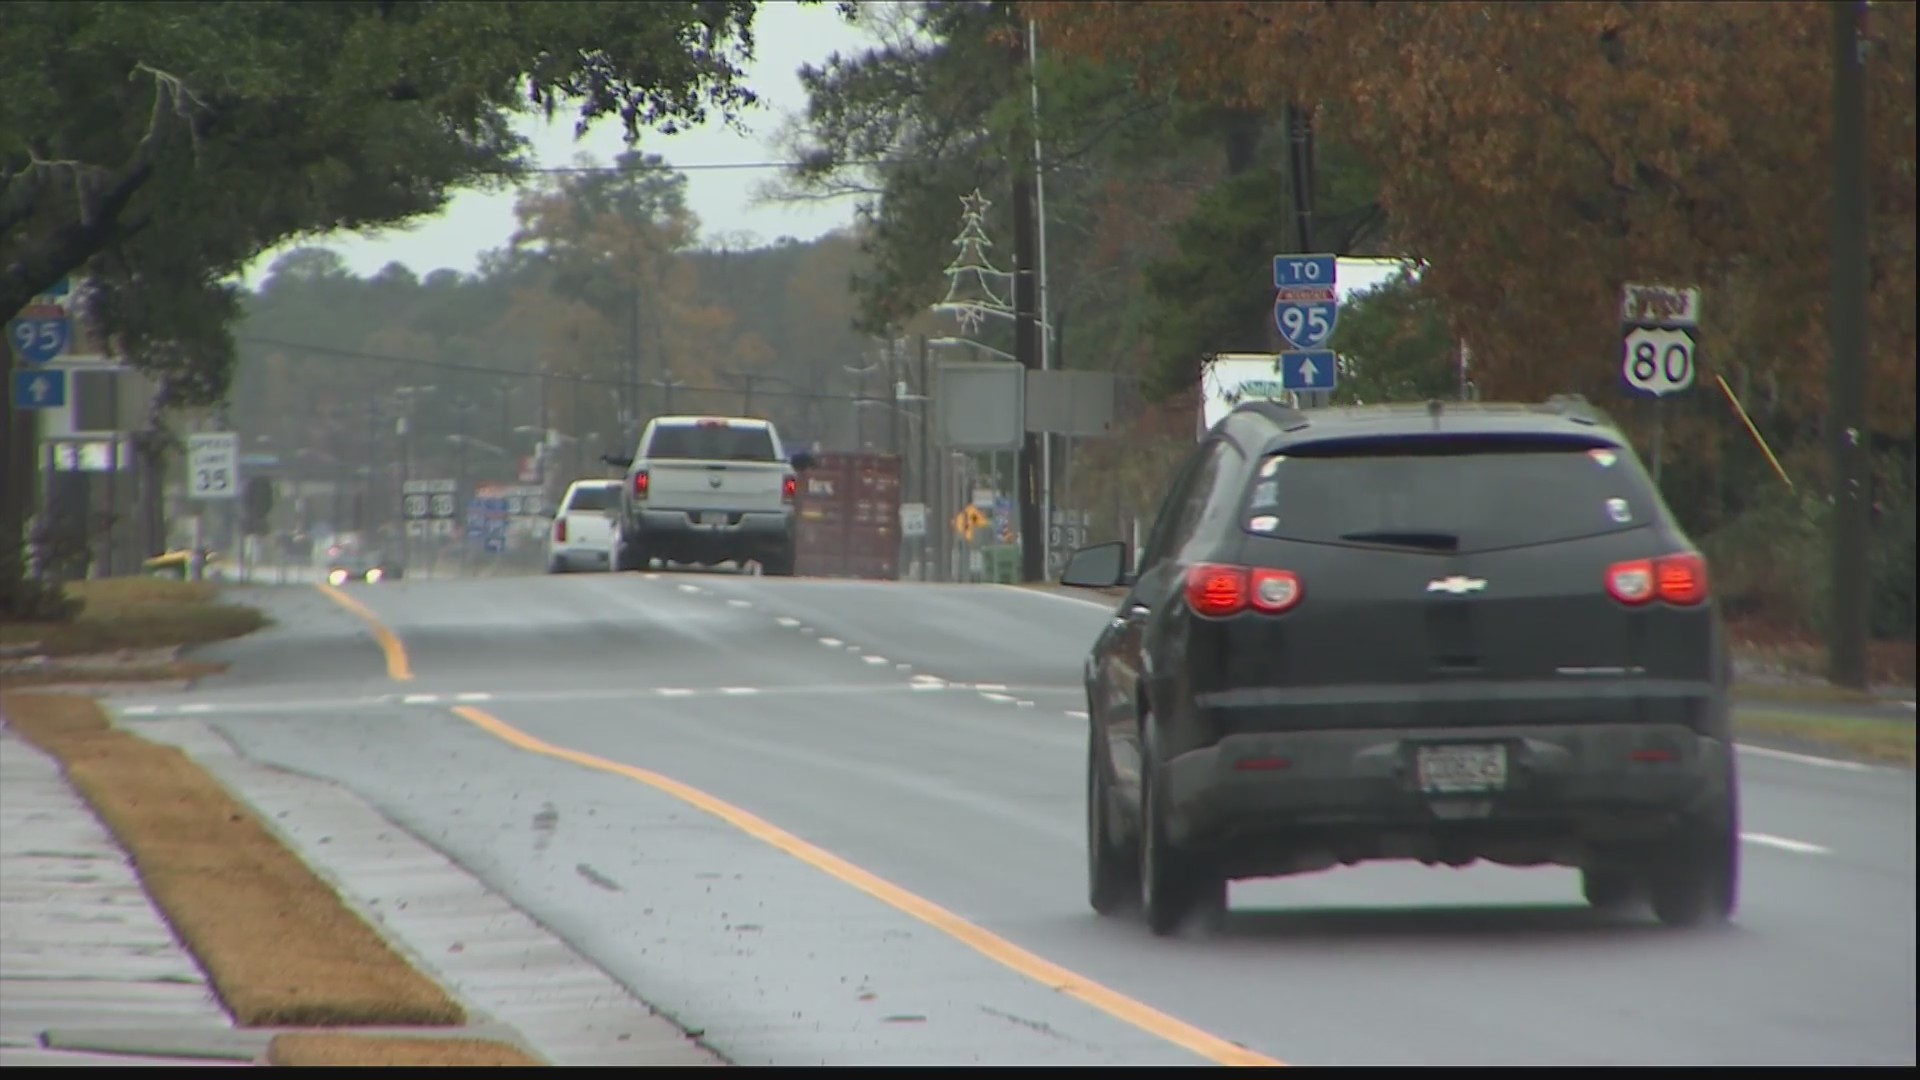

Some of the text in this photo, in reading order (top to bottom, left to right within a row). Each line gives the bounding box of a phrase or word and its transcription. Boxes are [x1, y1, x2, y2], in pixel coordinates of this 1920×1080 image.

[1289, 261, 1321, 280] TO
[15, 321, 60, 351] 95
[1282, 307, 1330, 341] 95
[1633, 341, 1689, 383] 80
[192, 438, 233, 449] SPEED
[195, 453, 227, 464] LIMIT
[196, 467, 228, 491] 35
